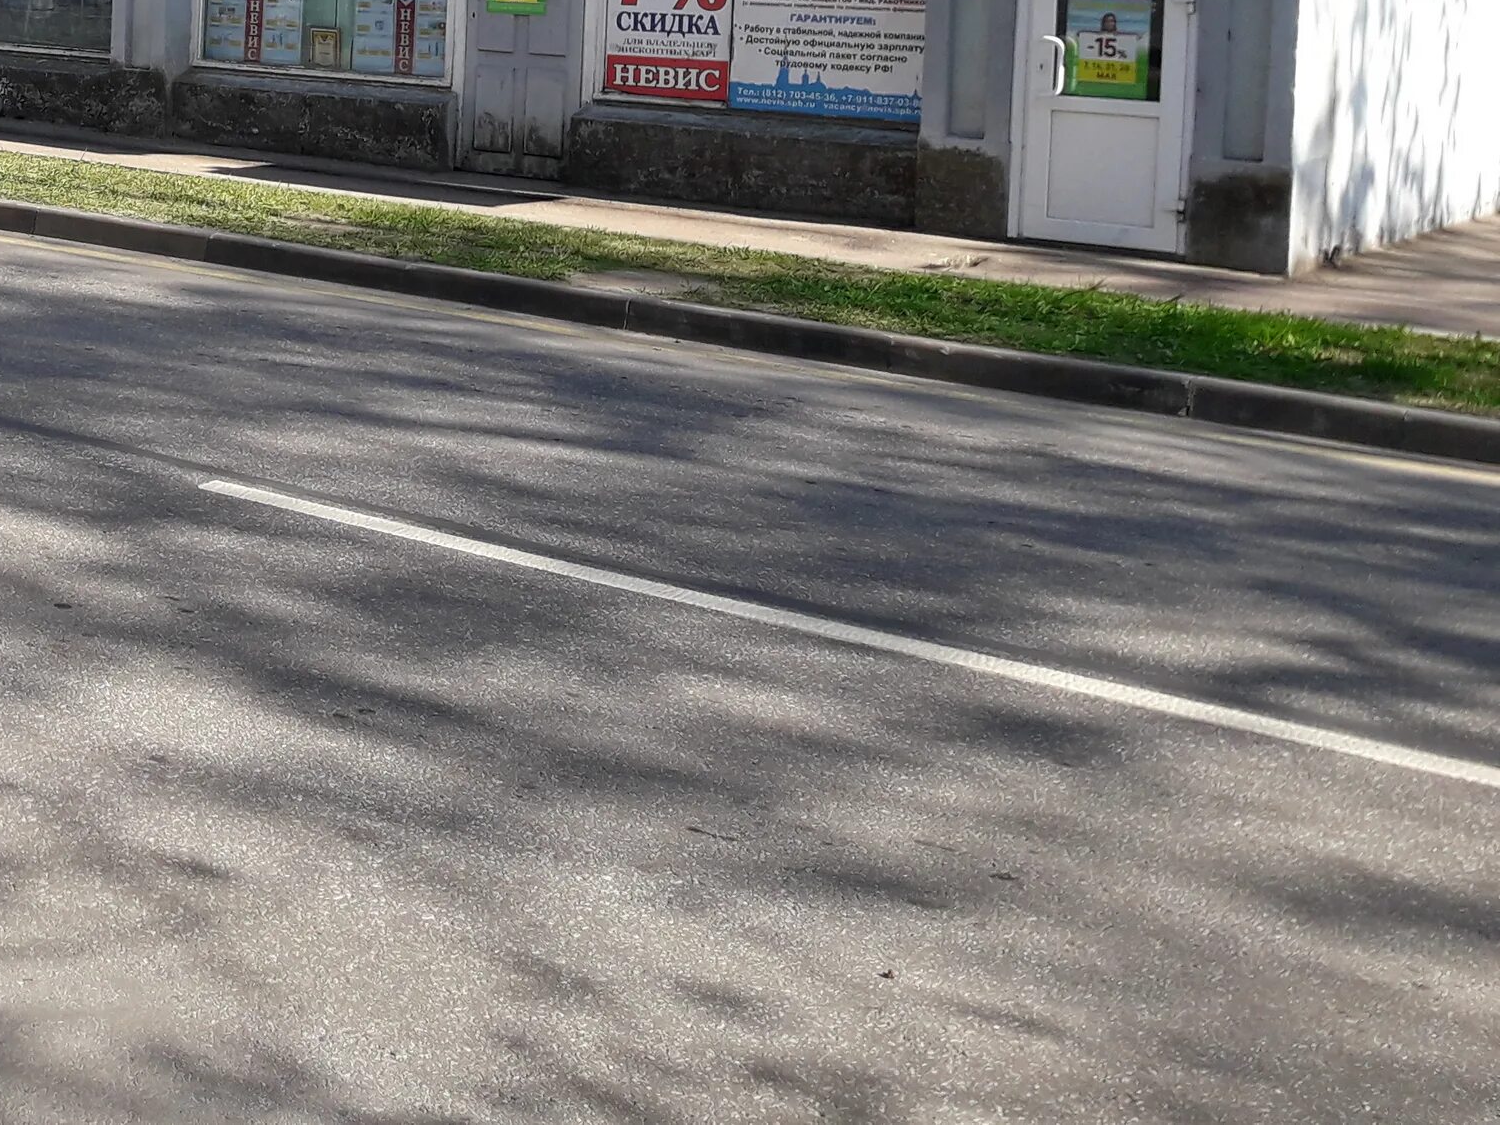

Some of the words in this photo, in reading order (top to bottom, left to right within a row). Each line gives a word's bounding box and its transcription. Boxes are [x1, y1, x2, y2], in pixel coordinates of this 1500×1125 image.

[247, 1, 260, 61] НЕВИС
[616, 11, 722, 37] СКИДКА
[744, 24, 774, 35] Работу
[783, 27, 836, 37] стабильной,
[838, 29, 882, 39] надежной
[399, 8, 412, 73] НЕВИС
[746, 35, 800, 47] Достойную
[802, 37, 875, 51] официальную
[877, 43, 924, 55] зарплату
[1086, 37, 1127, 59] -15%
[764, 47, 826, 59] Социальный
[829, 51, 858, 61] пакет
[860, 54, 908, 63] согласно
[775, 59, 828, 71] трудовому
[830, 63, 872, 74] кодексу
[613, 63, 720, 91] НЕВИС
[736, 97, 816, 109] www.nevis.spb.ru
[738, 87, 760, 96] Тел.:
[762, 88, 787, 99] (812)
